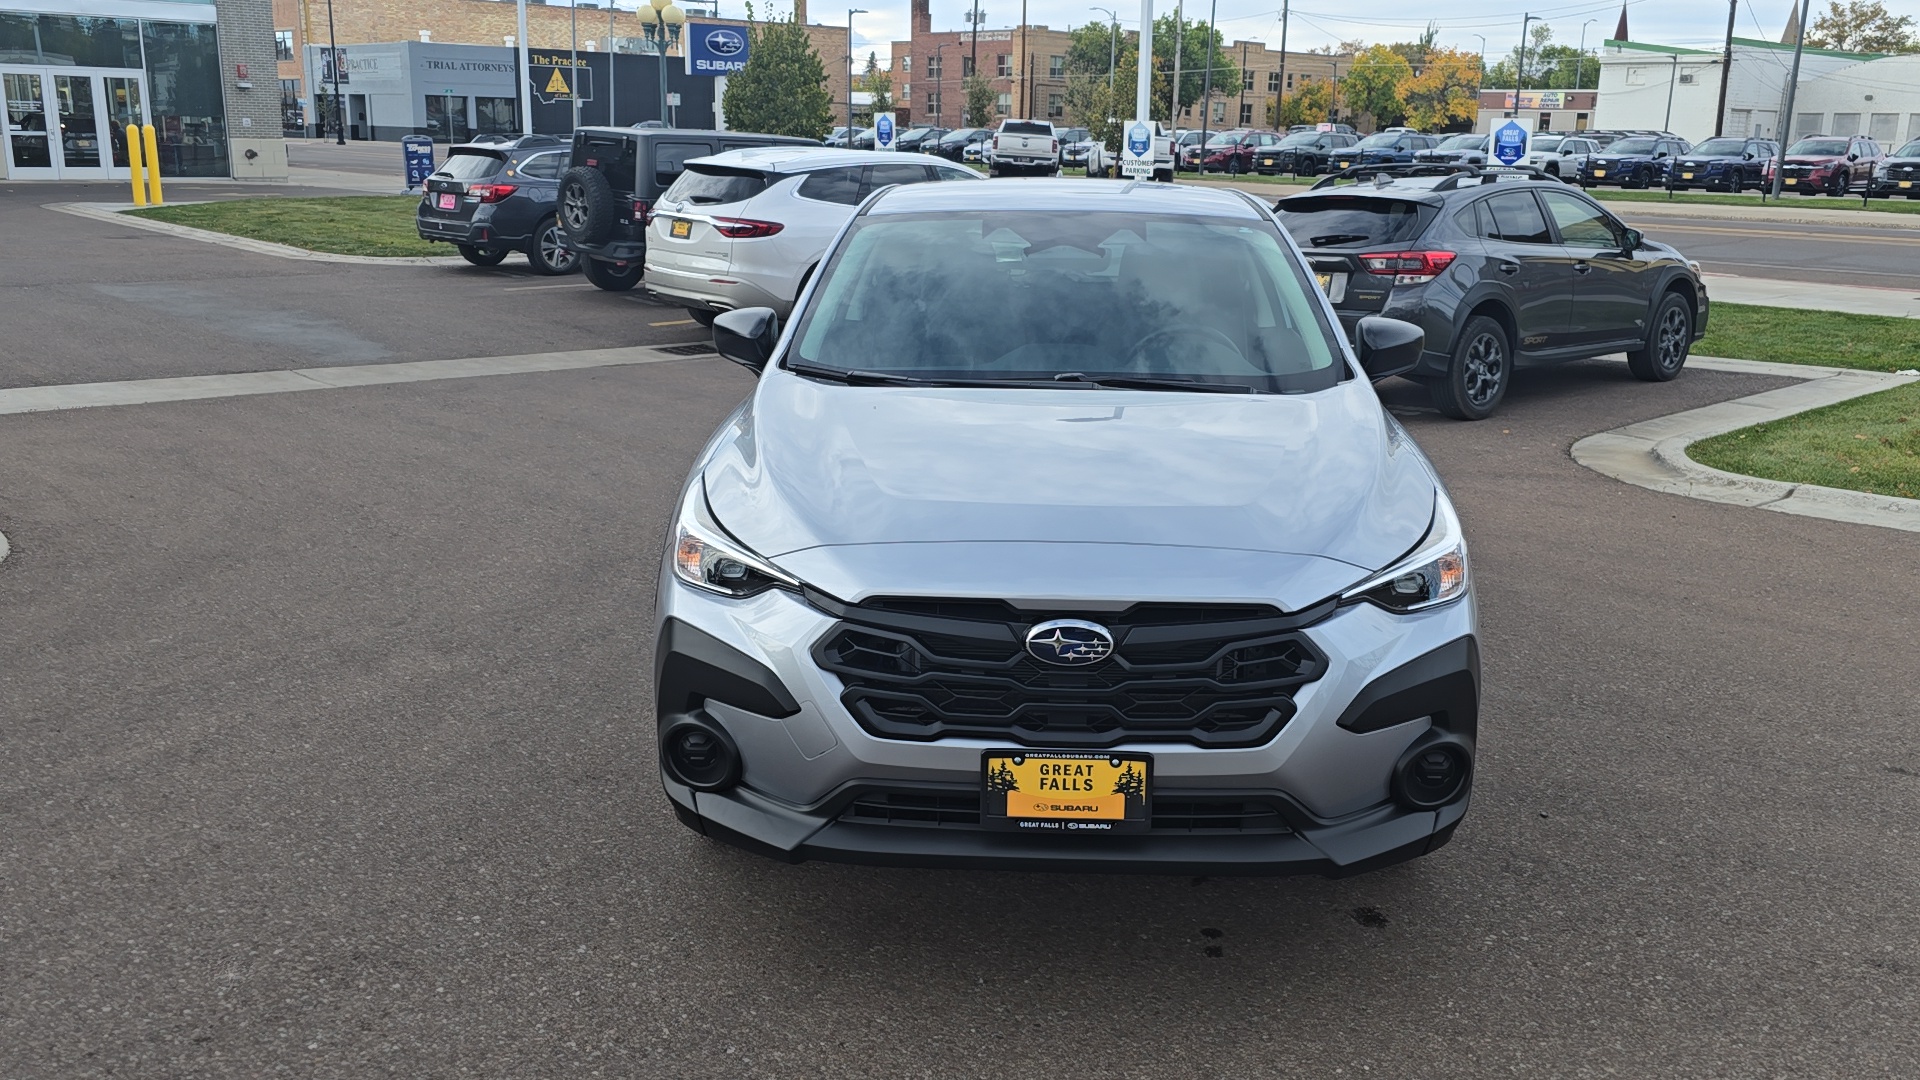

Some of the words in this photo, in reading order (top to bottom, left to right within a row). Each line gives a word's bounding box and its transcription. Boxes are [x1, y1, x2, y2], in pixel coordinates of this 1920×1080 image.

[426, 60, 457, 70] TRIAL
[459, 61, 515, 73] ATTORNEYS
[532, 54, 550, 65] The
[552, 55, 587, 67] Pracice
[697, 60, 745, 71] SUBAR
[1523, 336, 1549, 345] SPORT
[1039, 763, 1094, 777] GREAT
[1039, 778, 1094, 791] FALLS
